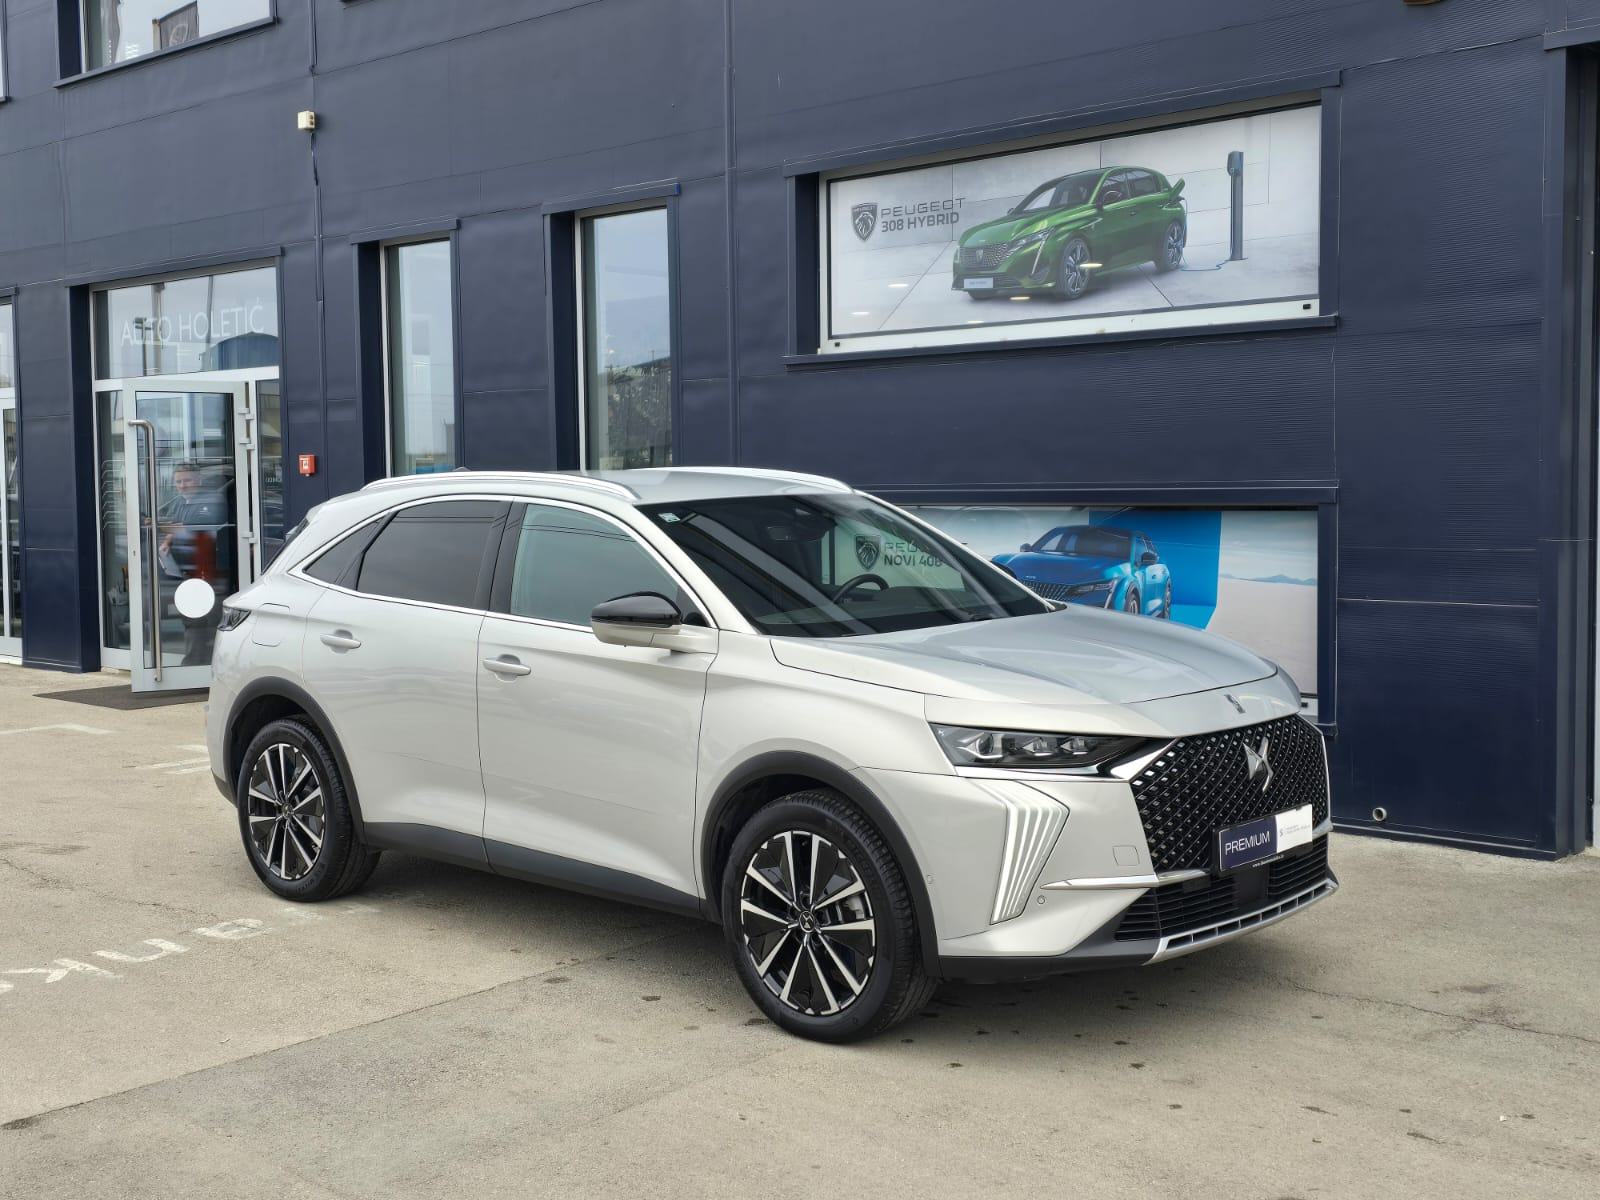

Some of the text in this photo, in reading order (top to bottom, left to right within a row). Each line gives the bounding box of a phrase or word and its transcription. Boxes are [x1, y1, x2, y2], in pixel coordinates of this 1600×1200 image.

[880, 198, 966, 219] PEUGEOT
[881, 212, 960, 232] 308 HYBRID
[121, 297, 265, 346] AUTO HOLETIĆ
[884, 554, 916, 567] NOVI
[1225, 831, 1270, 855] PREMIUM
